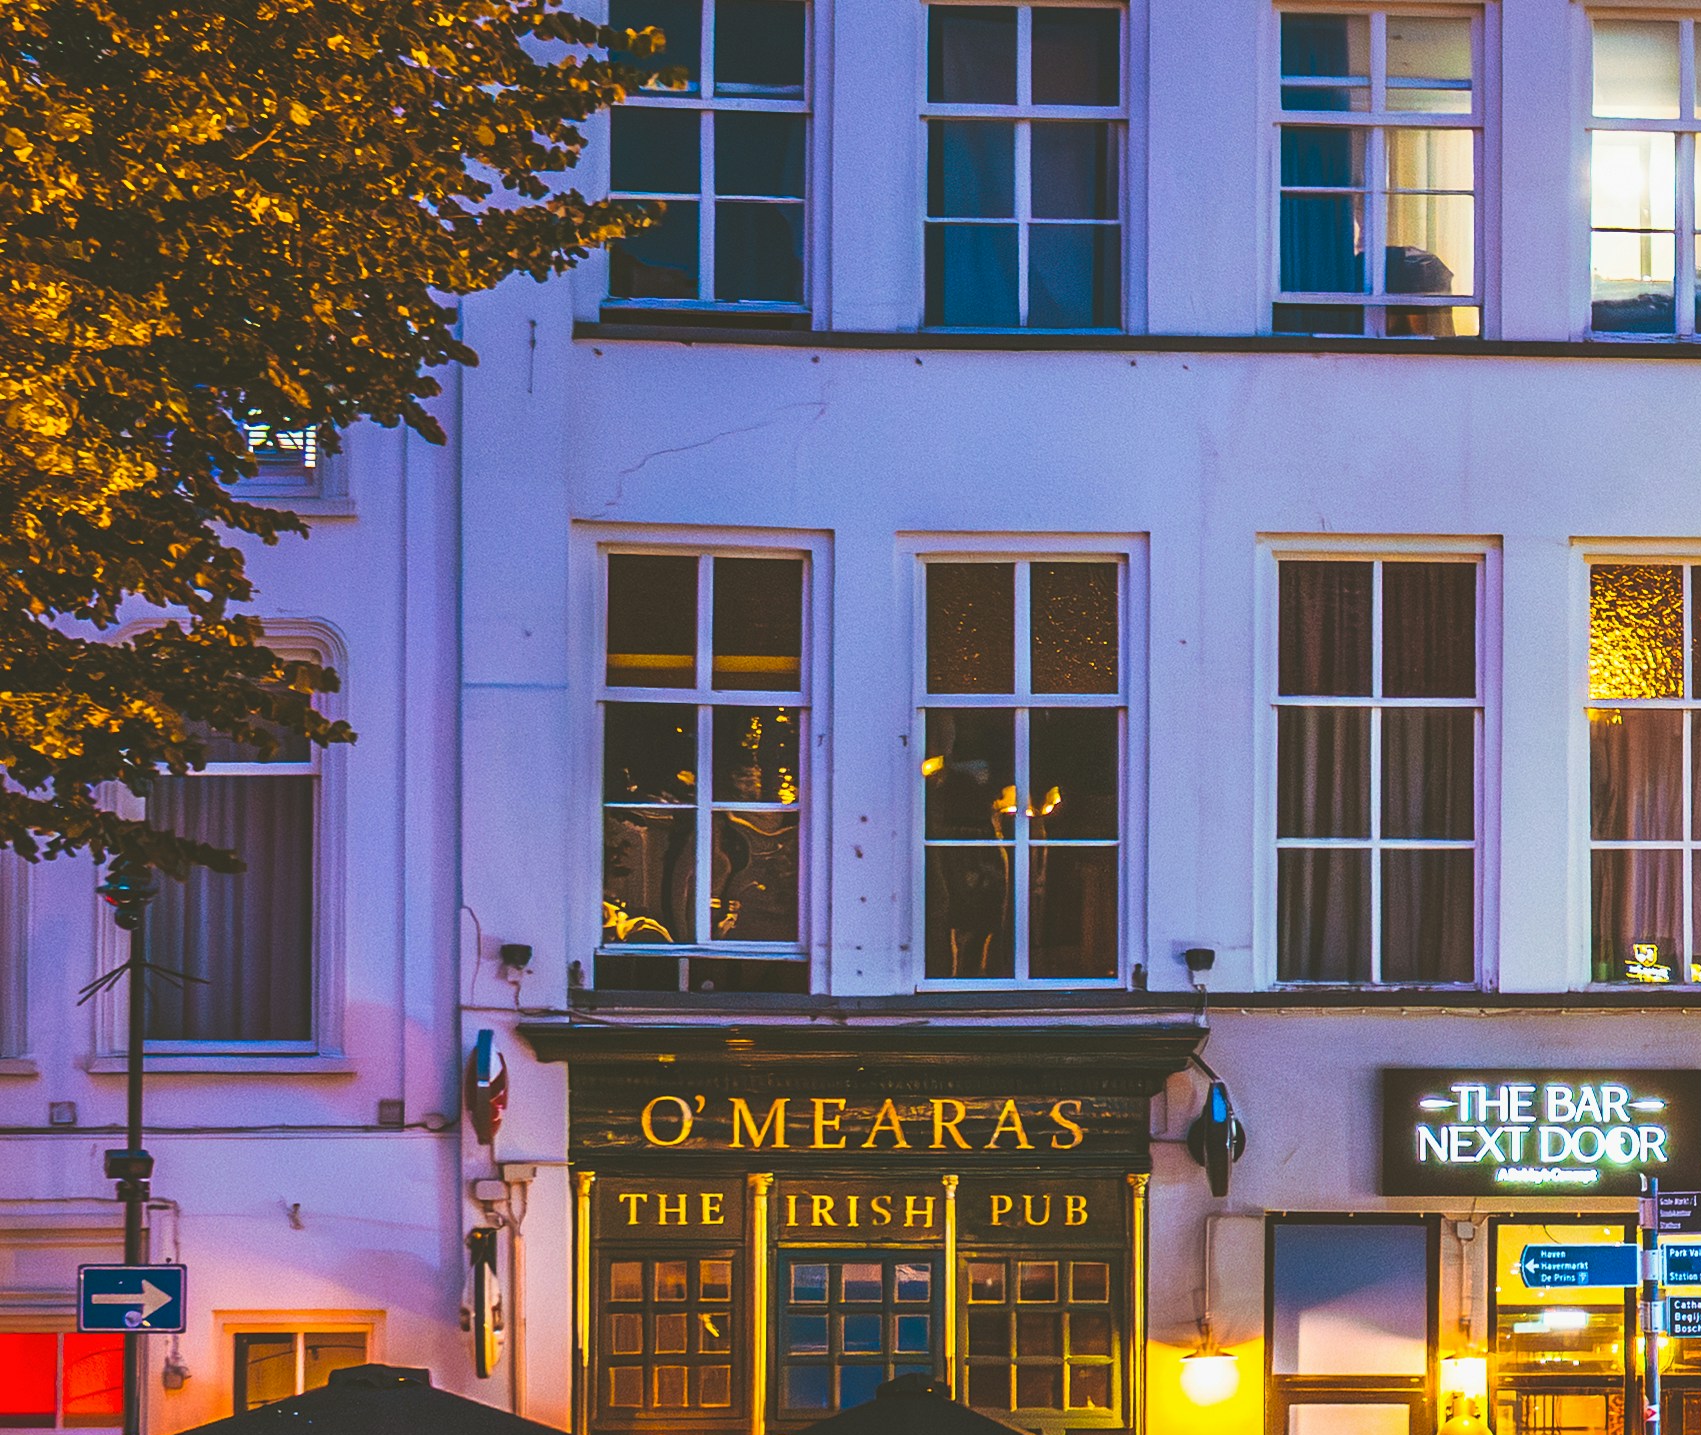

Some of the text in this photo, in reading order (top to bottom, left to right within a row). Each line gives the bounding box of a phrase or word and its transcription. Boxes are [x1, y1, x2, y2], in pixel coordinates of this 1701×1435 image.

[1450, 1083, 1632, 1123] THE BAR
[640, 1094, 1084, 1150] O'MEARAS
[1417, 1125, 1668, 1164] NEXT DOOR
[619, 1193, 1088, 1228] THE IRISH PUB
[1541, 1250, 1566, 1259] Haven
[1669, 1248, 1688, 1258] Park
[1541, 1261, 1589, 1270] Havermarkt
[1541, 1273, 1576, 1282] De Prins
[1669, 1272, 1698, 1282] Station
